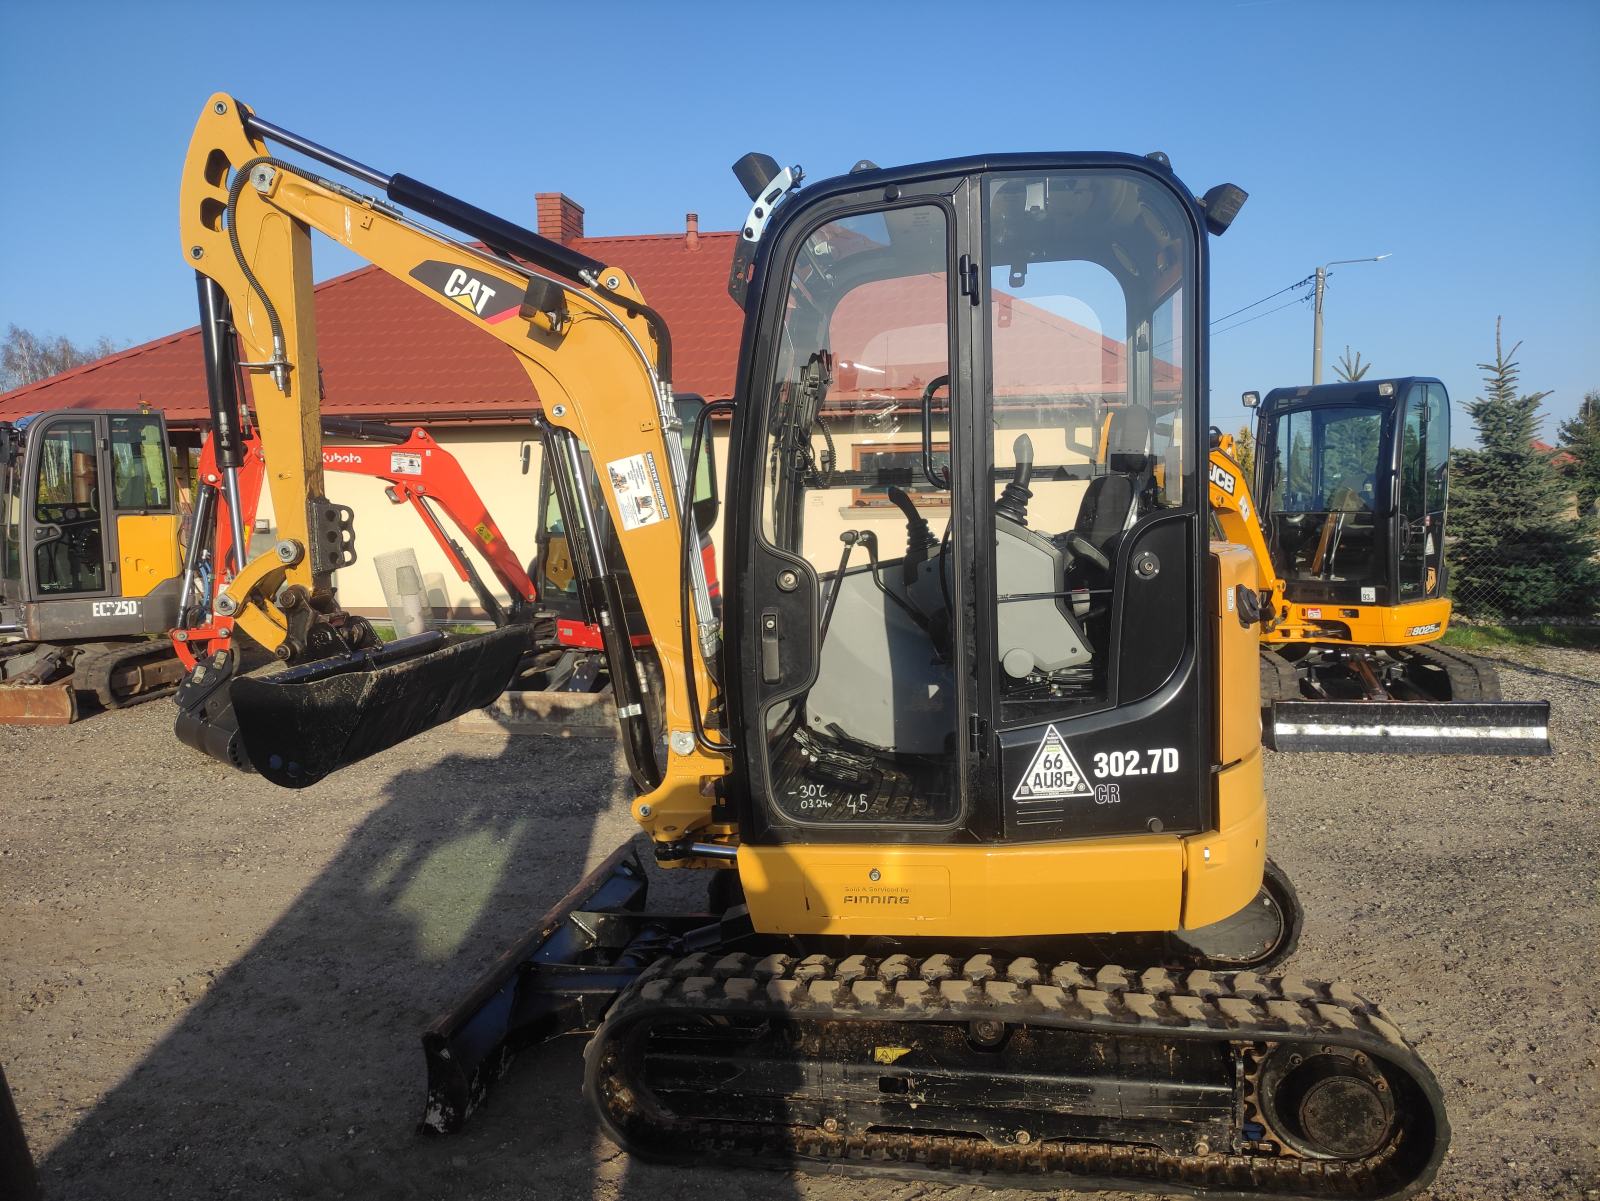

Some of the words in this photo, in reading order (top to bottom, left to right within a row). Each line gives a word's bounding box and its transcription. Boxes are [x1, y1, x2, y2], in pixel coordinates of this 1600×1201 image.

[444, 269, 496, 315] CAT
[1209, 464, 1235, 494] JCB
[1043, 753, 1063, 770] 66
[1094, 748, 1179, 778] 302.7D
[847, 794, 868, 814] 45
[1095, 784, 1120, 804] CR
